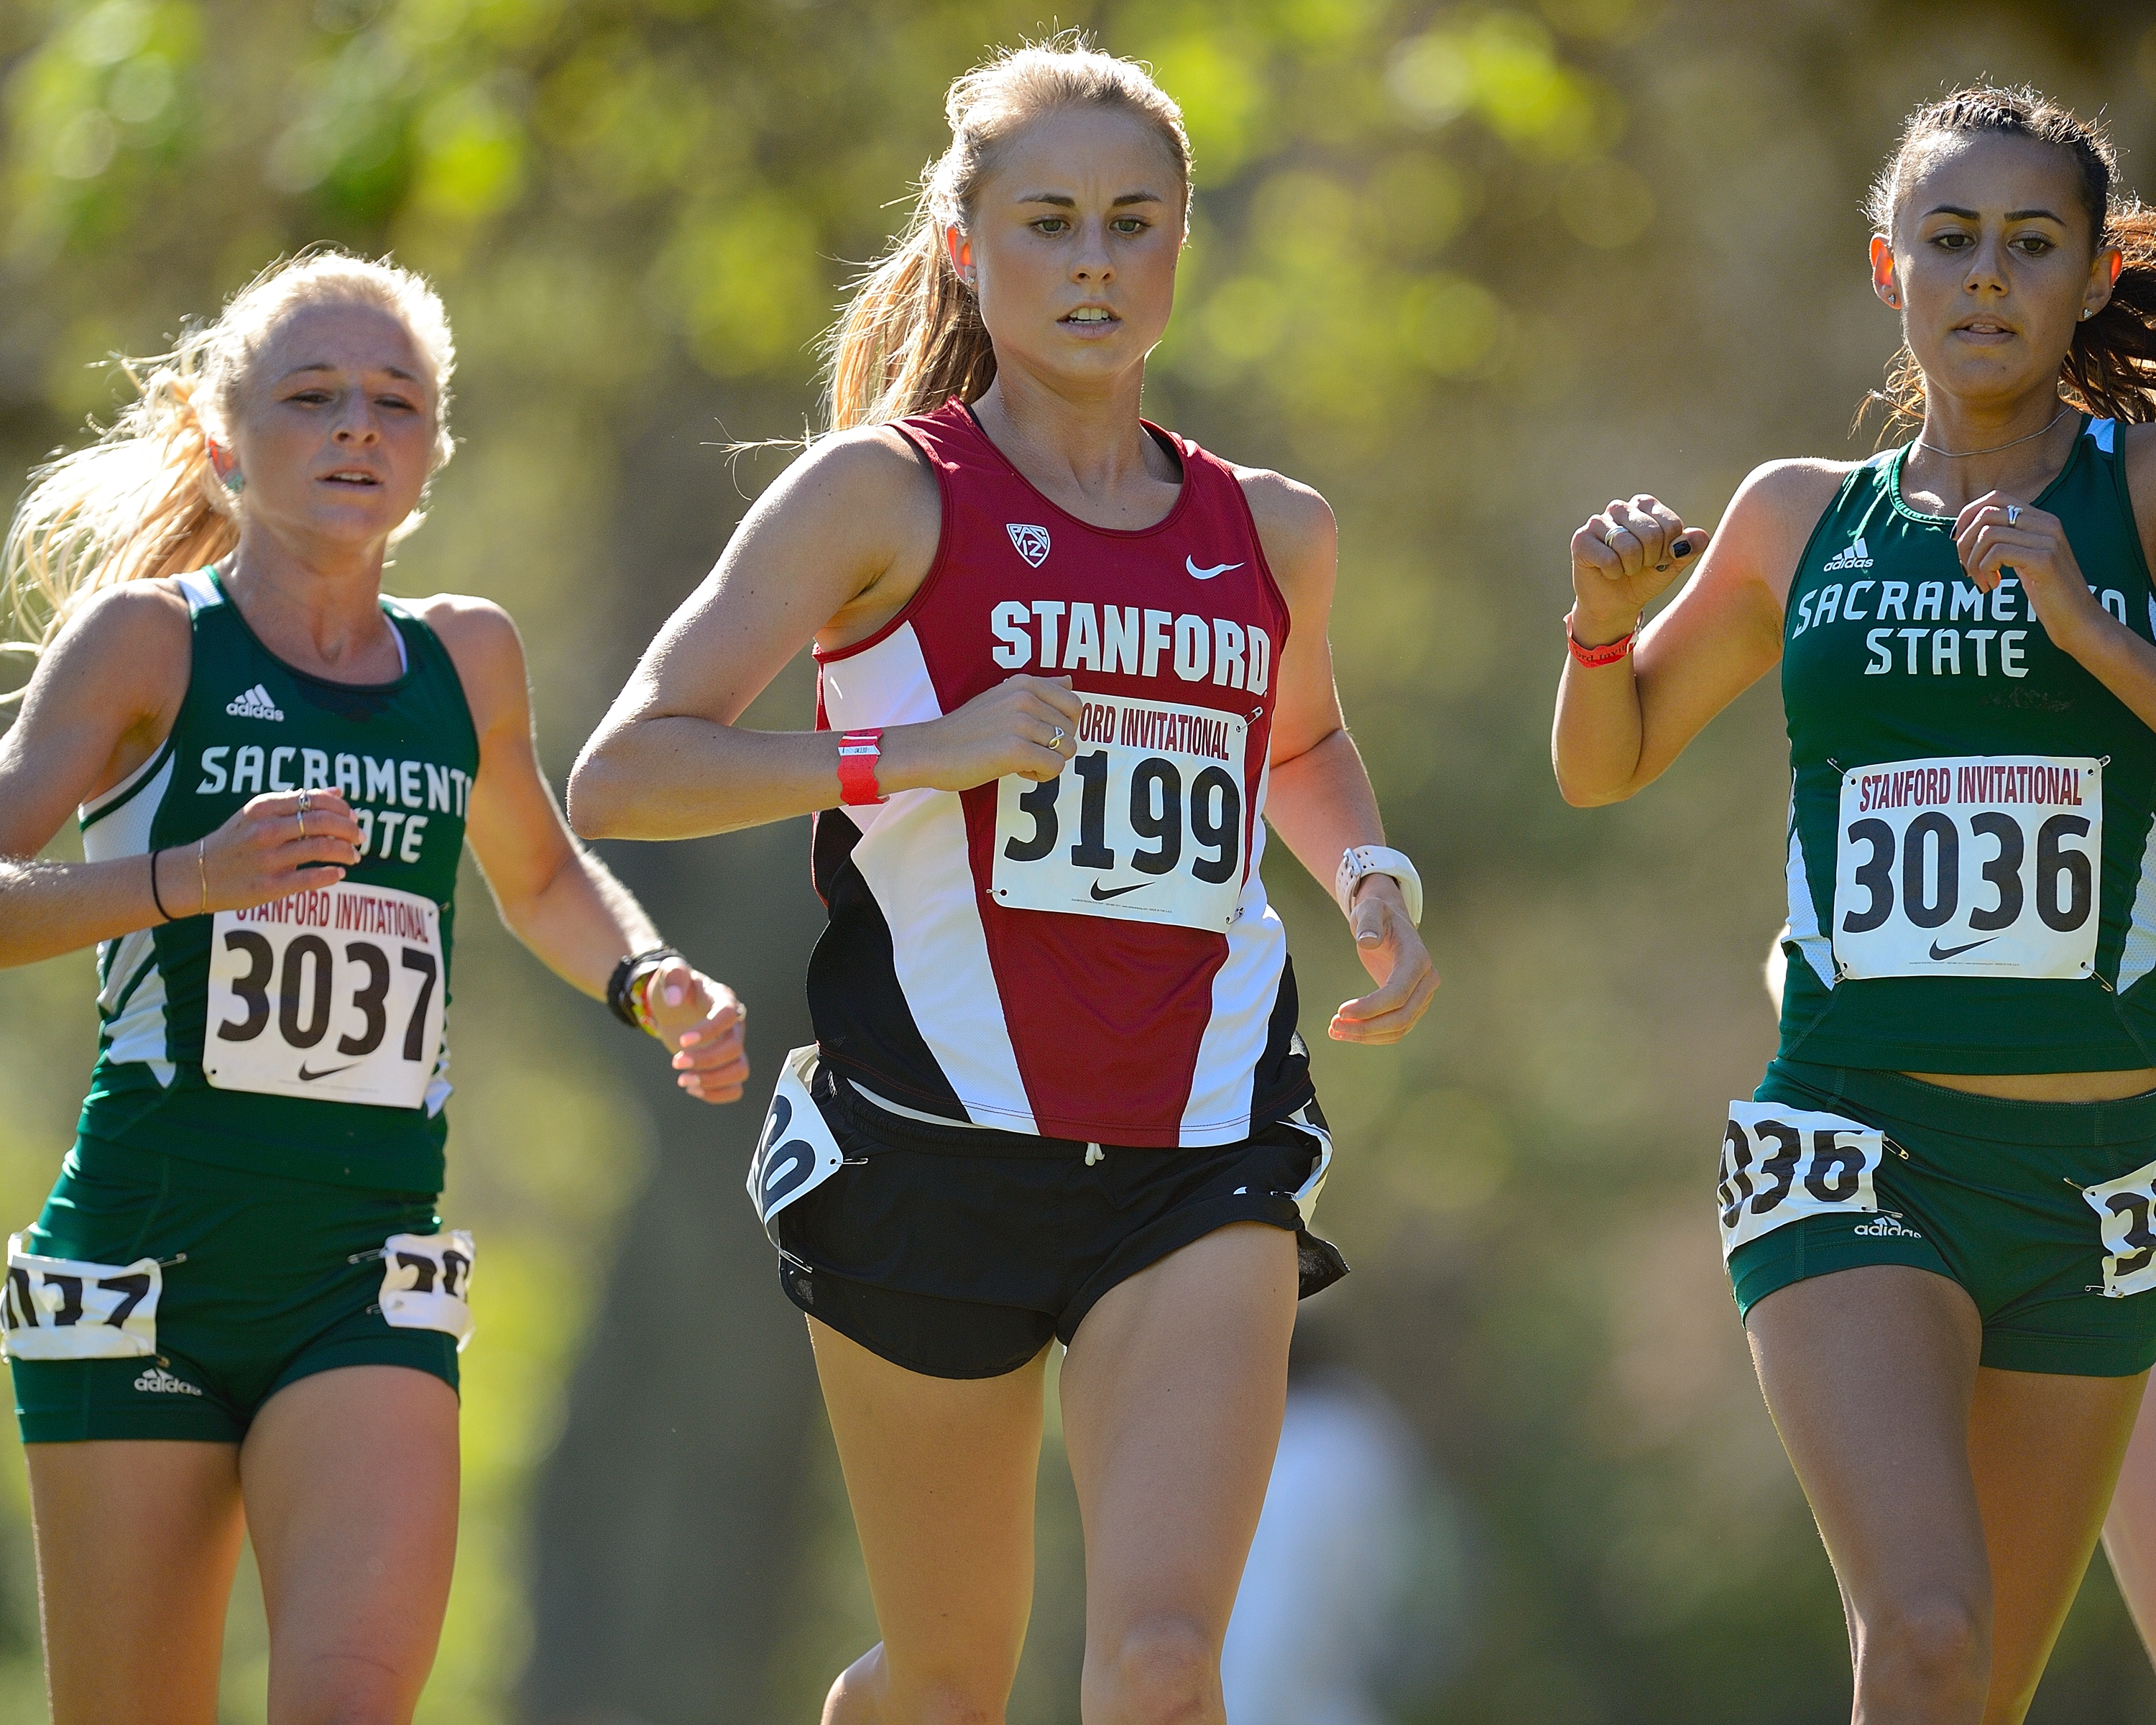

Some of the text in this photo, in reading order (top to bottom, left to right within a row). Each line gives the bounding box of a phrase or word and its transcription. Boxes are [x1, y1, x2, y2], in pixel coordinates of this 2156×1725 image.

[1009, 525, 1048, 550] PAC
[1022, 539, 1044, 557] 12
[1823, 557, 1874, 572] adidas
[1792, 578, 2127, 640] SACRAMEO
[991, 600, 1271, 696] STANFORD
[1864, 627, 2030, 678] STATE
[226, 702, 285, 722] adidas
[1120, 707, 1230, 761] INVITATIONAL
[1858, 765, 2083, 812] STANFORD INVITATIONAL
[353, 807, 430, 864] ATE
[1003, 750, 1241, 884] 3199
[1841, 811, 2091, 934] 3036
[335, 893, 429, 944] INVITATIONAL
[216, 930, 437, 1062] 3037
[1717, 1119, 1867, 1228] 036
